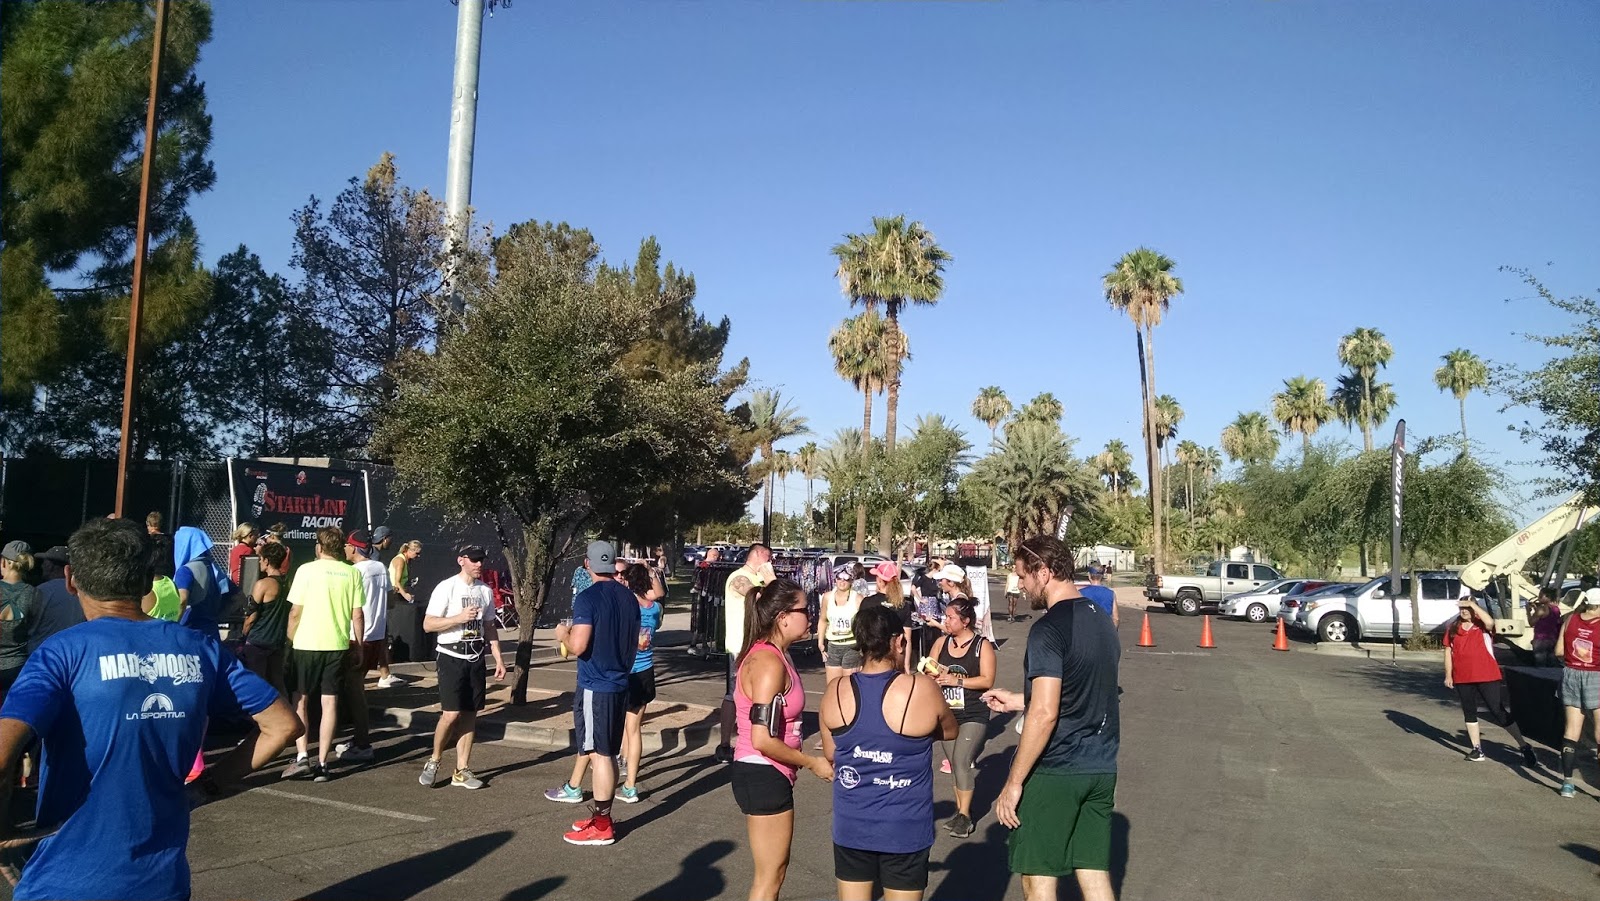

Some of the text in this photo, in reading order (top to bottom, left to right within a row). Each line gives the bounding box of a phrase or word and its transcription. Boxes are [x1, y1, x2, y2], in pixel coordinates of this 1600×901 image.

[265, 491, 347, 515] STARTLINE
[301, 516, 343, 528] RACING
[99, 653, 202, 681] MAD MOOSE
[125, 711, 186, 720] LA SPORTIVA
